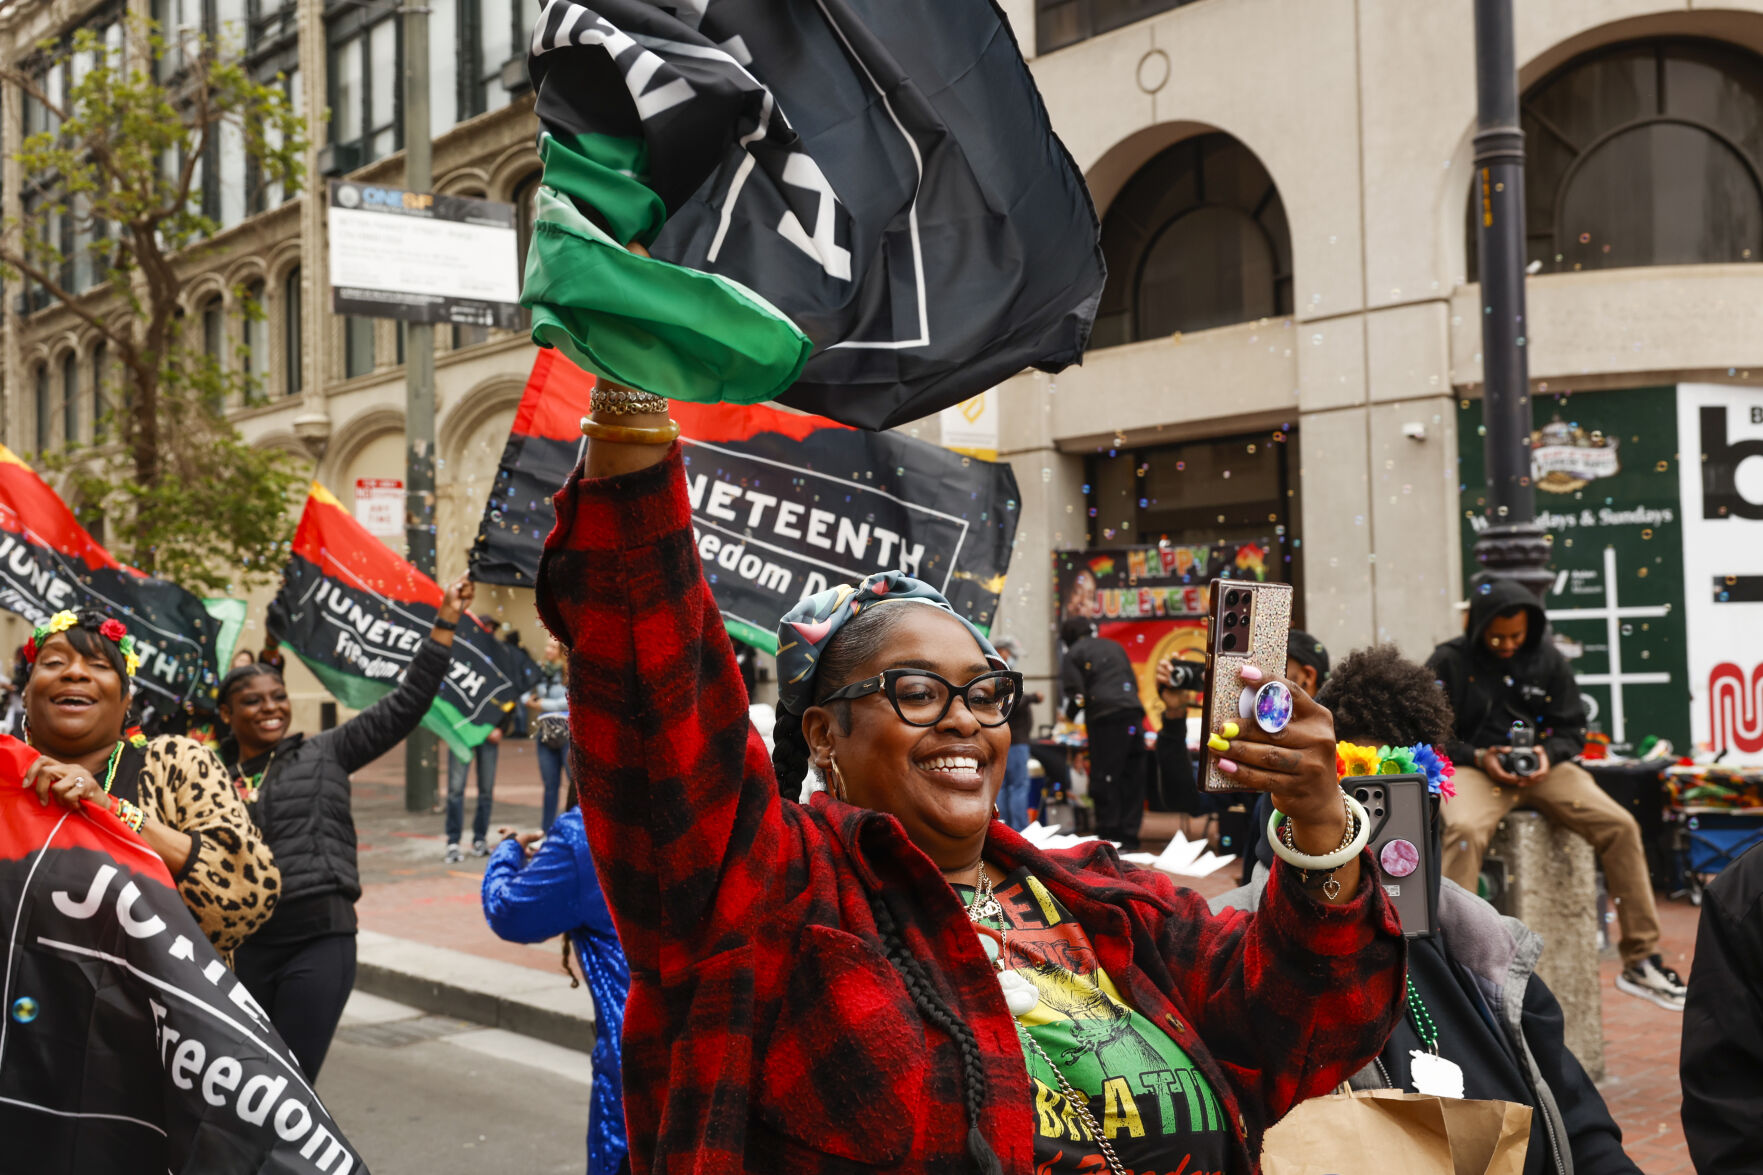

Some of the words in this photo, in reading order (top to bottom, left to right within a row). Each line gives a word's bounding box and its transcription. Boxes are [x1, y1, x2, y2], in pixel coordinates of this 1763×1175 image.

[684, 470, 925, 578] NETEENTH
[1580, 509, 1596, 526] &
[1598, 505, 1674, 527] Sundays
[694, 526, 793, 595] edom
[1127, 546, 1210, 578] HAPPY
[1092, 586, 1211, 619] JUNETEE
[314, 580, 486, 698] JUNETETH
